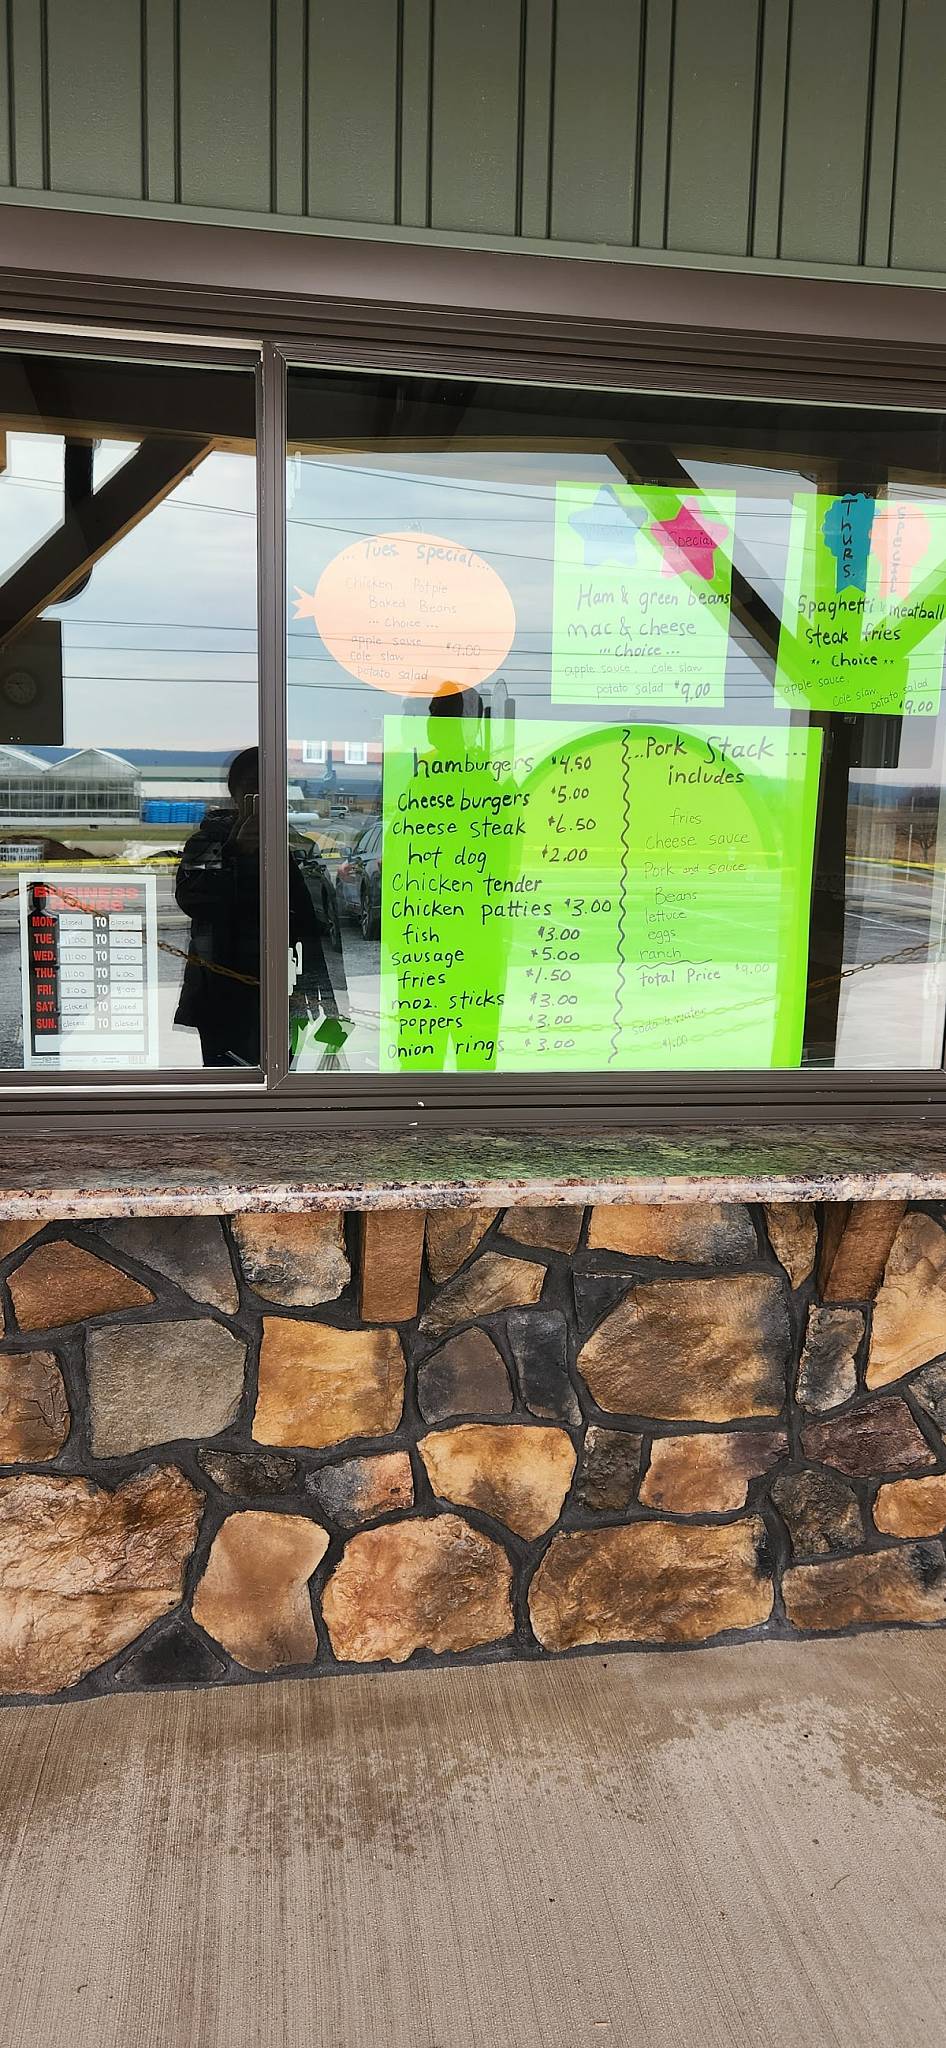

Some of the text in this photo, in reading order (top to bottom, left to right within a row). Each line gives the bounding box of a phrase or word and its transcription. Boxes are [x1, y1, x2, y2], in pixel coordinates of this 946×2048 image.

[577, 583, 614, 611] Ham
[639, 591, 679, 615] green
[688, 586, 731, 606] beans
[797, 594, 875, 621] Spaghetti
[567, 622, 613, 639] mac
[861, 622, 902, 643] fries
[399, 668, 429, 681] salad
[412, 747, 592, 782] hamburgers $4.50
[667, 765, 745, 786] includes
[551, 785, 590, 804] $5.00
[547, 813, 597, 835] $6.50
[668, 807, 702, 825] fries
[708, 832, 751, 847] sauce
[408, 842, 488, 874] hot dog
[643, 861, 675, 879] Pork
[708, 862, 748, 875] sauce
[482, 874, 544, 896] tender
[655, 886, 698, 905] Beans
[51, 900, 124, 912] URS
[481, 901, 553, 926] patties
[564, 898, 612, 917] $3.00
[32, 916, 55, 927] MON.
[95, 916, 107, 928] TO
[645, 909, 688, 925] lettuce
[33, 933, 55, 945] TUE.
[95, 934, 108, 945] TO
[402, 923, 581, 945] fish $3.00
[647, 928, 677, 945] eggs
[33, 950, 56, 961] WED.
[95, 951, 108, 962] TO
[639, 947, 682, 960] ranch
[34, 967, 56, 978] THU.
[96, 967, 108, 978] TO
[397, 971, 446, 989] fries
[36, 984, 54, 996] FRI.
[96, 984, 108, 996] TO
[35, 1001, 57, 1012] SAT.
[96, 1001, 109, 1012] TO
[449, 989, 505, 1010] sticks
[36, 1018, 57, 1029] SUN.
[62, 1020, 87, 1029] close
[98, 1018, 109, 1029] TO
[399, 1016, 463, 1035] poppers
[455, 1035, 505, 1061] rings
